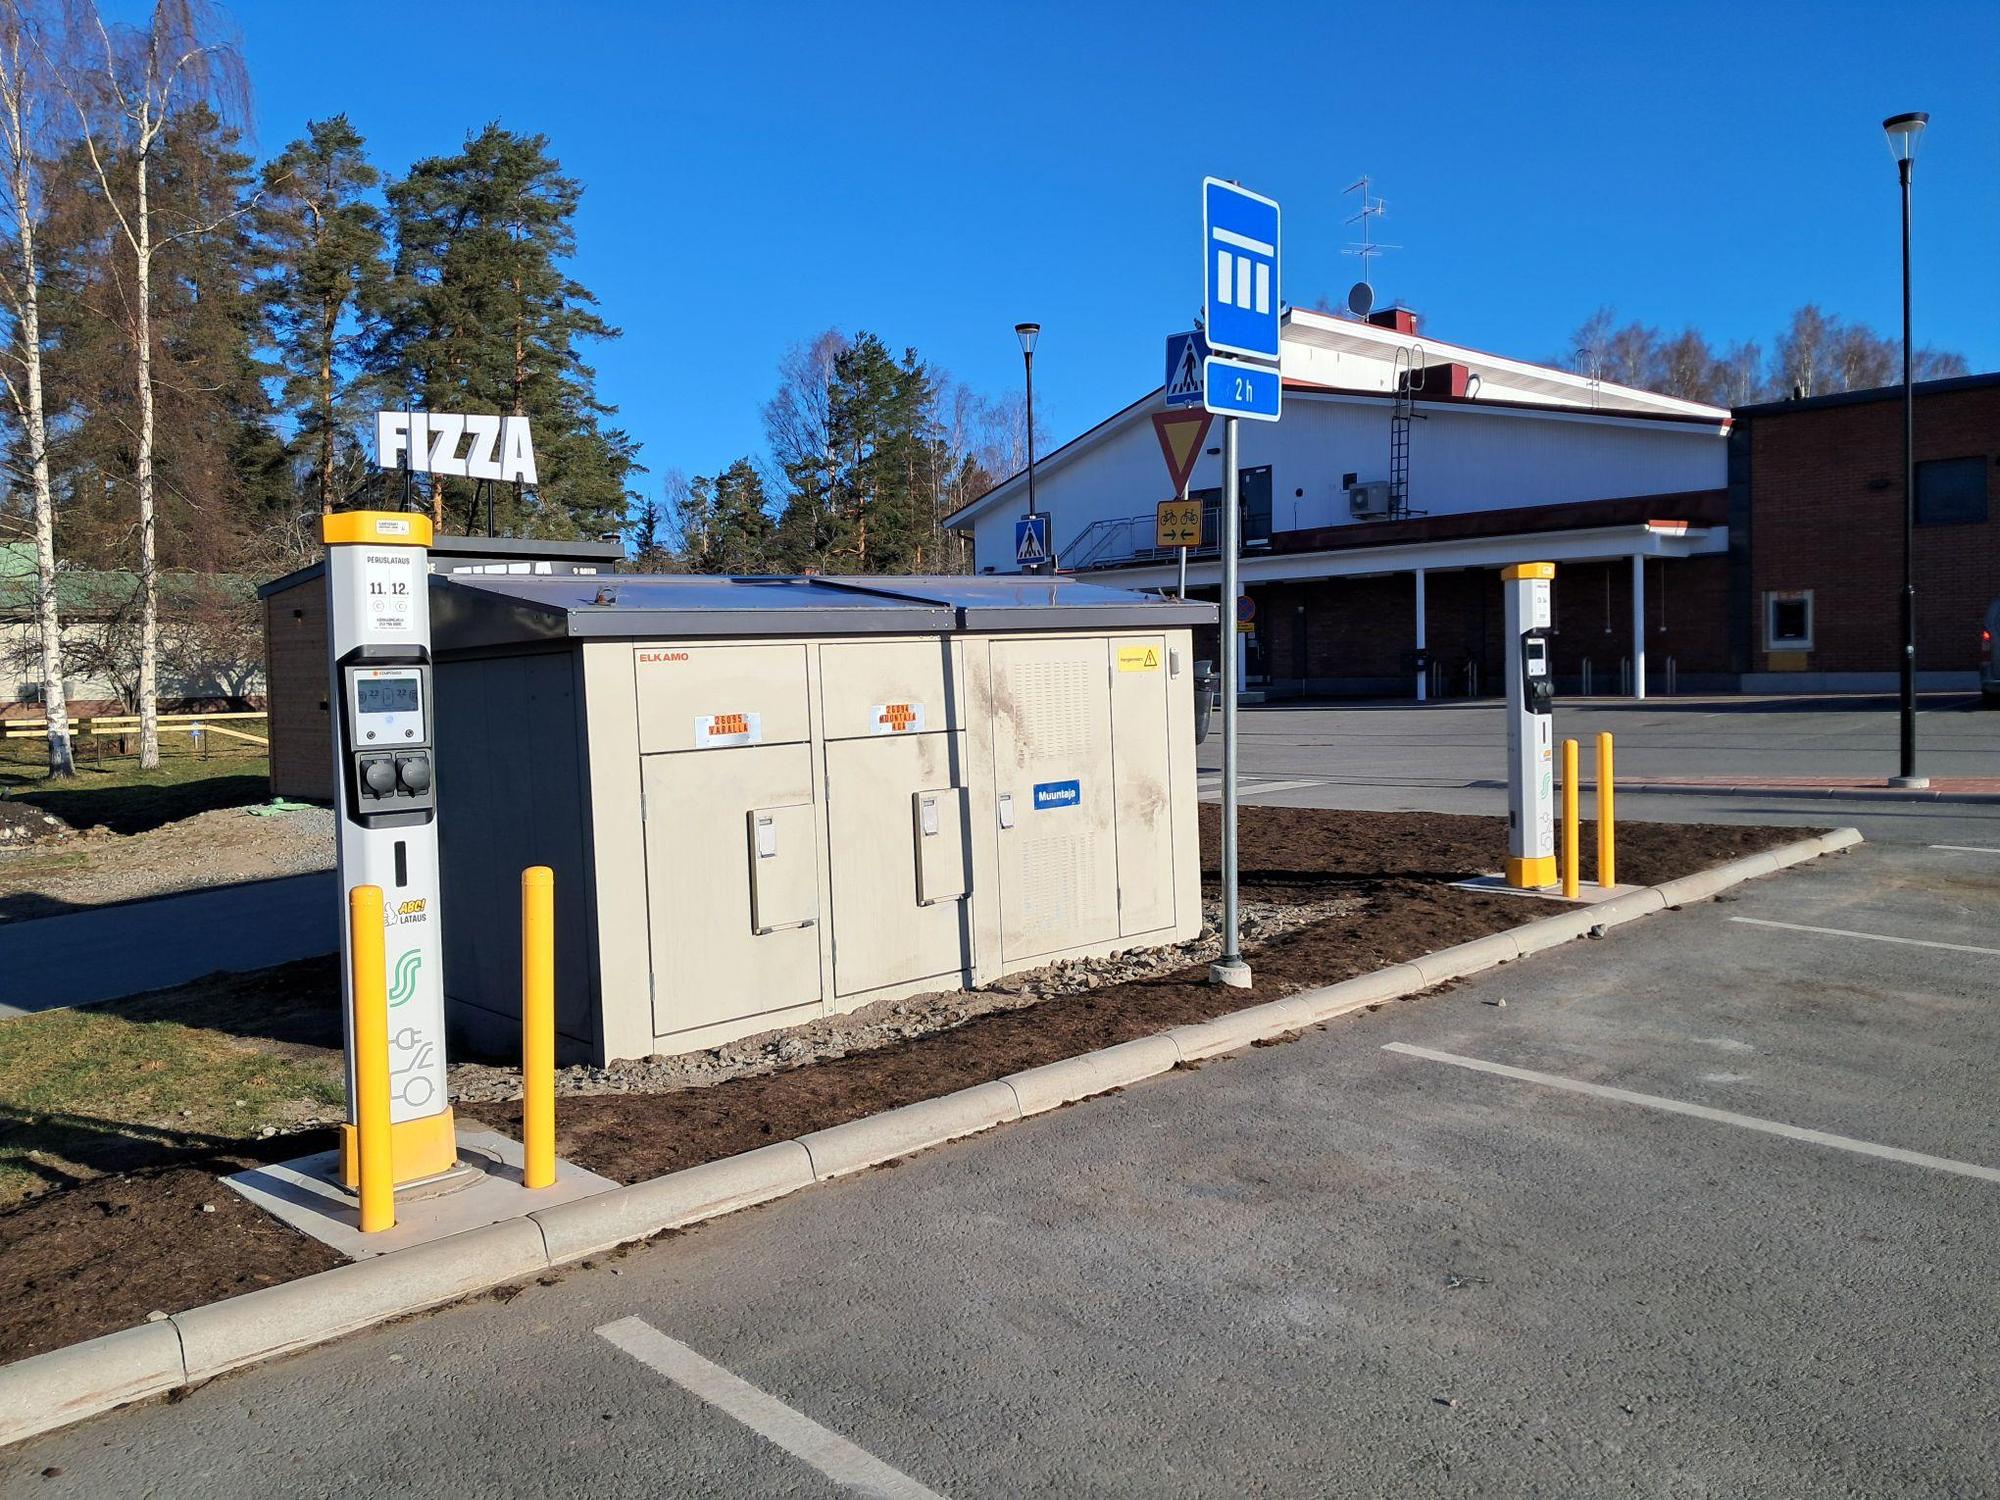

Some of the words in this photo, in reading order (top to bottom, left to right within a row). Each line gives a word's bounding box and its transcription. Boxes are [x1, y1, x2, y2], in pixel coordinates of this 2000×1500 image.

[1235, 377, 1243, 401] 2
[1246, 379, 1253, 403] h
[375, 411, 538, 484] FIZZA
[367, 556, 410, 565] PERUSLATAUS
[370, 582, 387, 595] 11.
[391, 583, 410, 595] 12.
[639, 653, 689, 662] ELKAMO
[714, 713, 743, 725] 26095
[879, 712, 916, 723] MUUNTAJA
[708, 723, 748, 735] VARALLA
[1038, 789, 1076, 802] Muuntaja
[398, 898, 427, 915] ABC!
[400, 914, 427, 925] LATAUS
